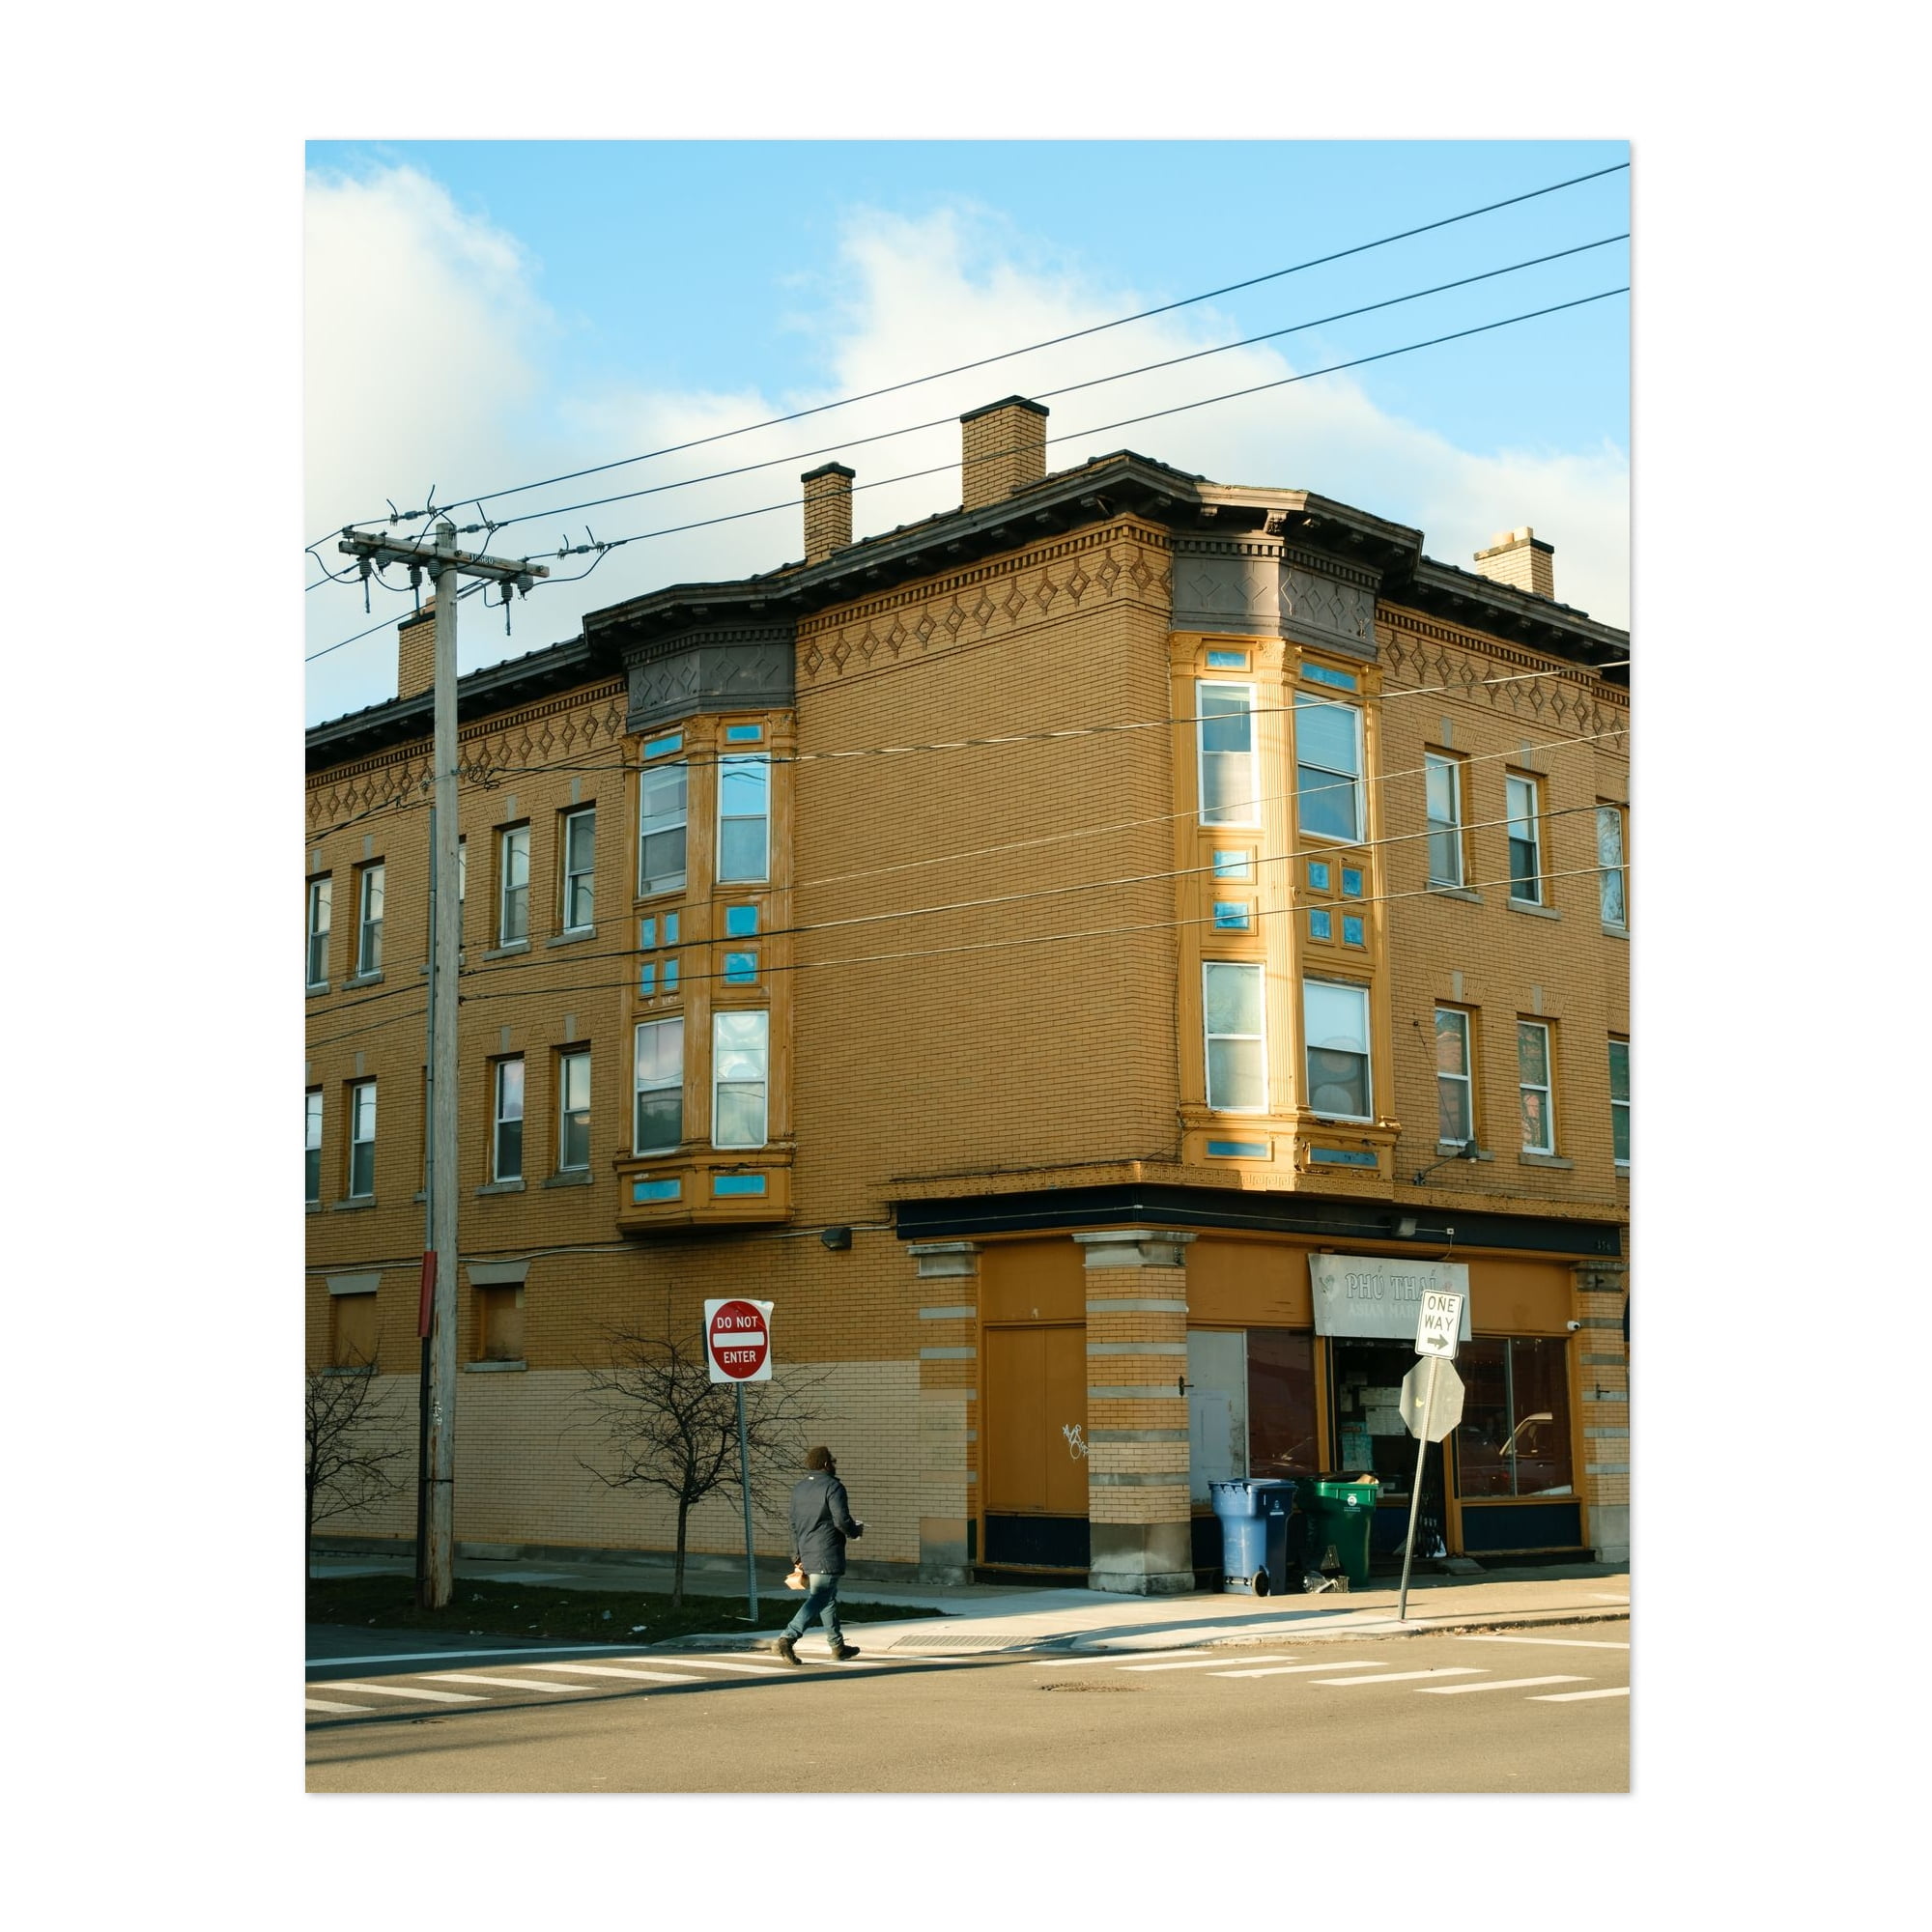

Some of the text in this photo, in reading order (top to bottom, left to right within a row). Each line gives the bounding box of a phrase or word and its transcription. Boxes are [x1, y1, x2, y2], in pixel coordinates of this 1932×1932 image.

[1428, 1295, 1456, 1313] ONE
[717, 1316, 757, 1328] DO NOT
[1425, 1314, 1454, 1331] WAY
[724, 1350, 756, 1364] ENTER
